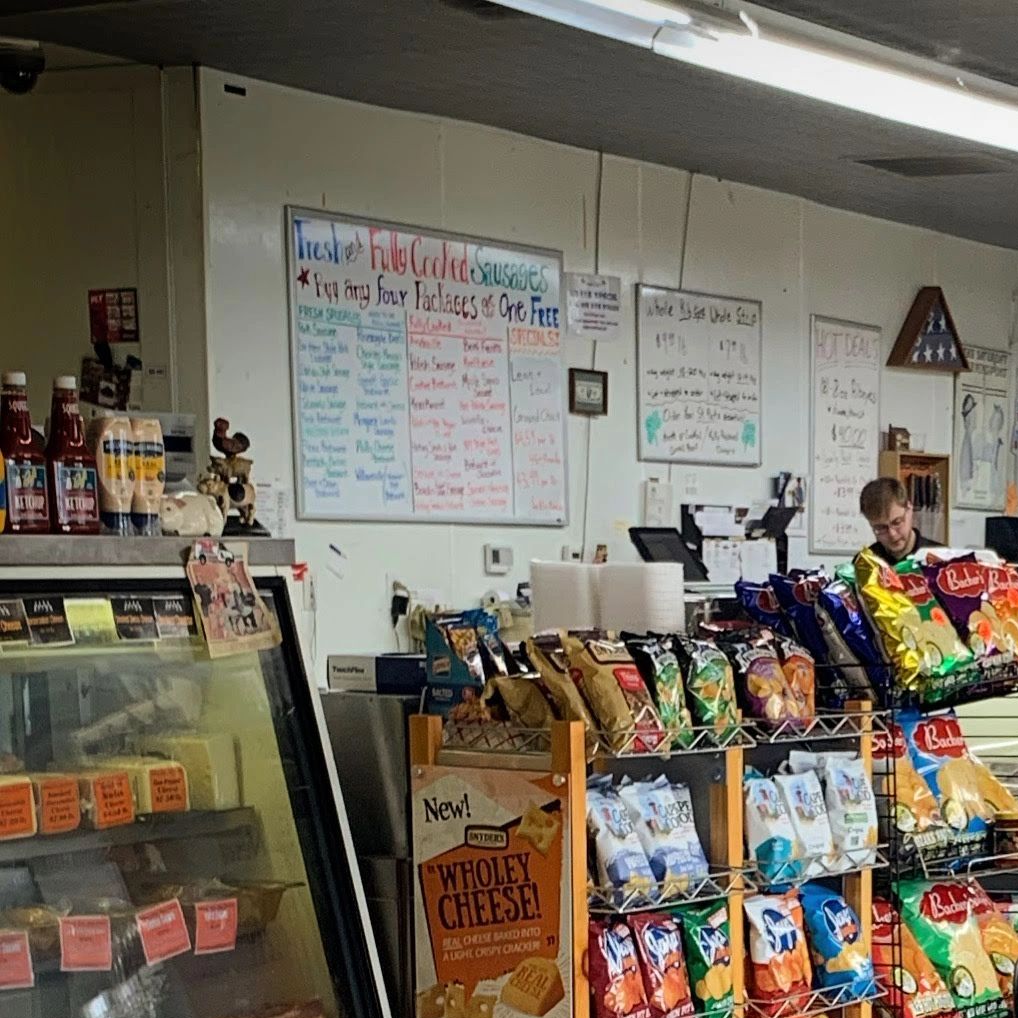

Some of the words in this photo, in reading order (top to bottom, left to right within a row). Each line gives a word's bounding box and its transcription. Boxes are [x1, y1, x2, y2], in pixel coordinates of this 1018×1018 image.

[368, 226, 408, 275] Fully
[411, 232, 469, 285] Cooked
[470, 246, 549, 294] Sausages
[415, 280, 478, 320] Packages
[499, 292, 527, 323] One
[530, 295, 560, 329] FREE
[423, 793, 472, 824] New!
[438, 881, 543, 931] CHEESE!
[463, 932, 494, 946] CHEESE
[519, 926, 542, 941] INTO
[474, 944, 501, 958] CRISPY
